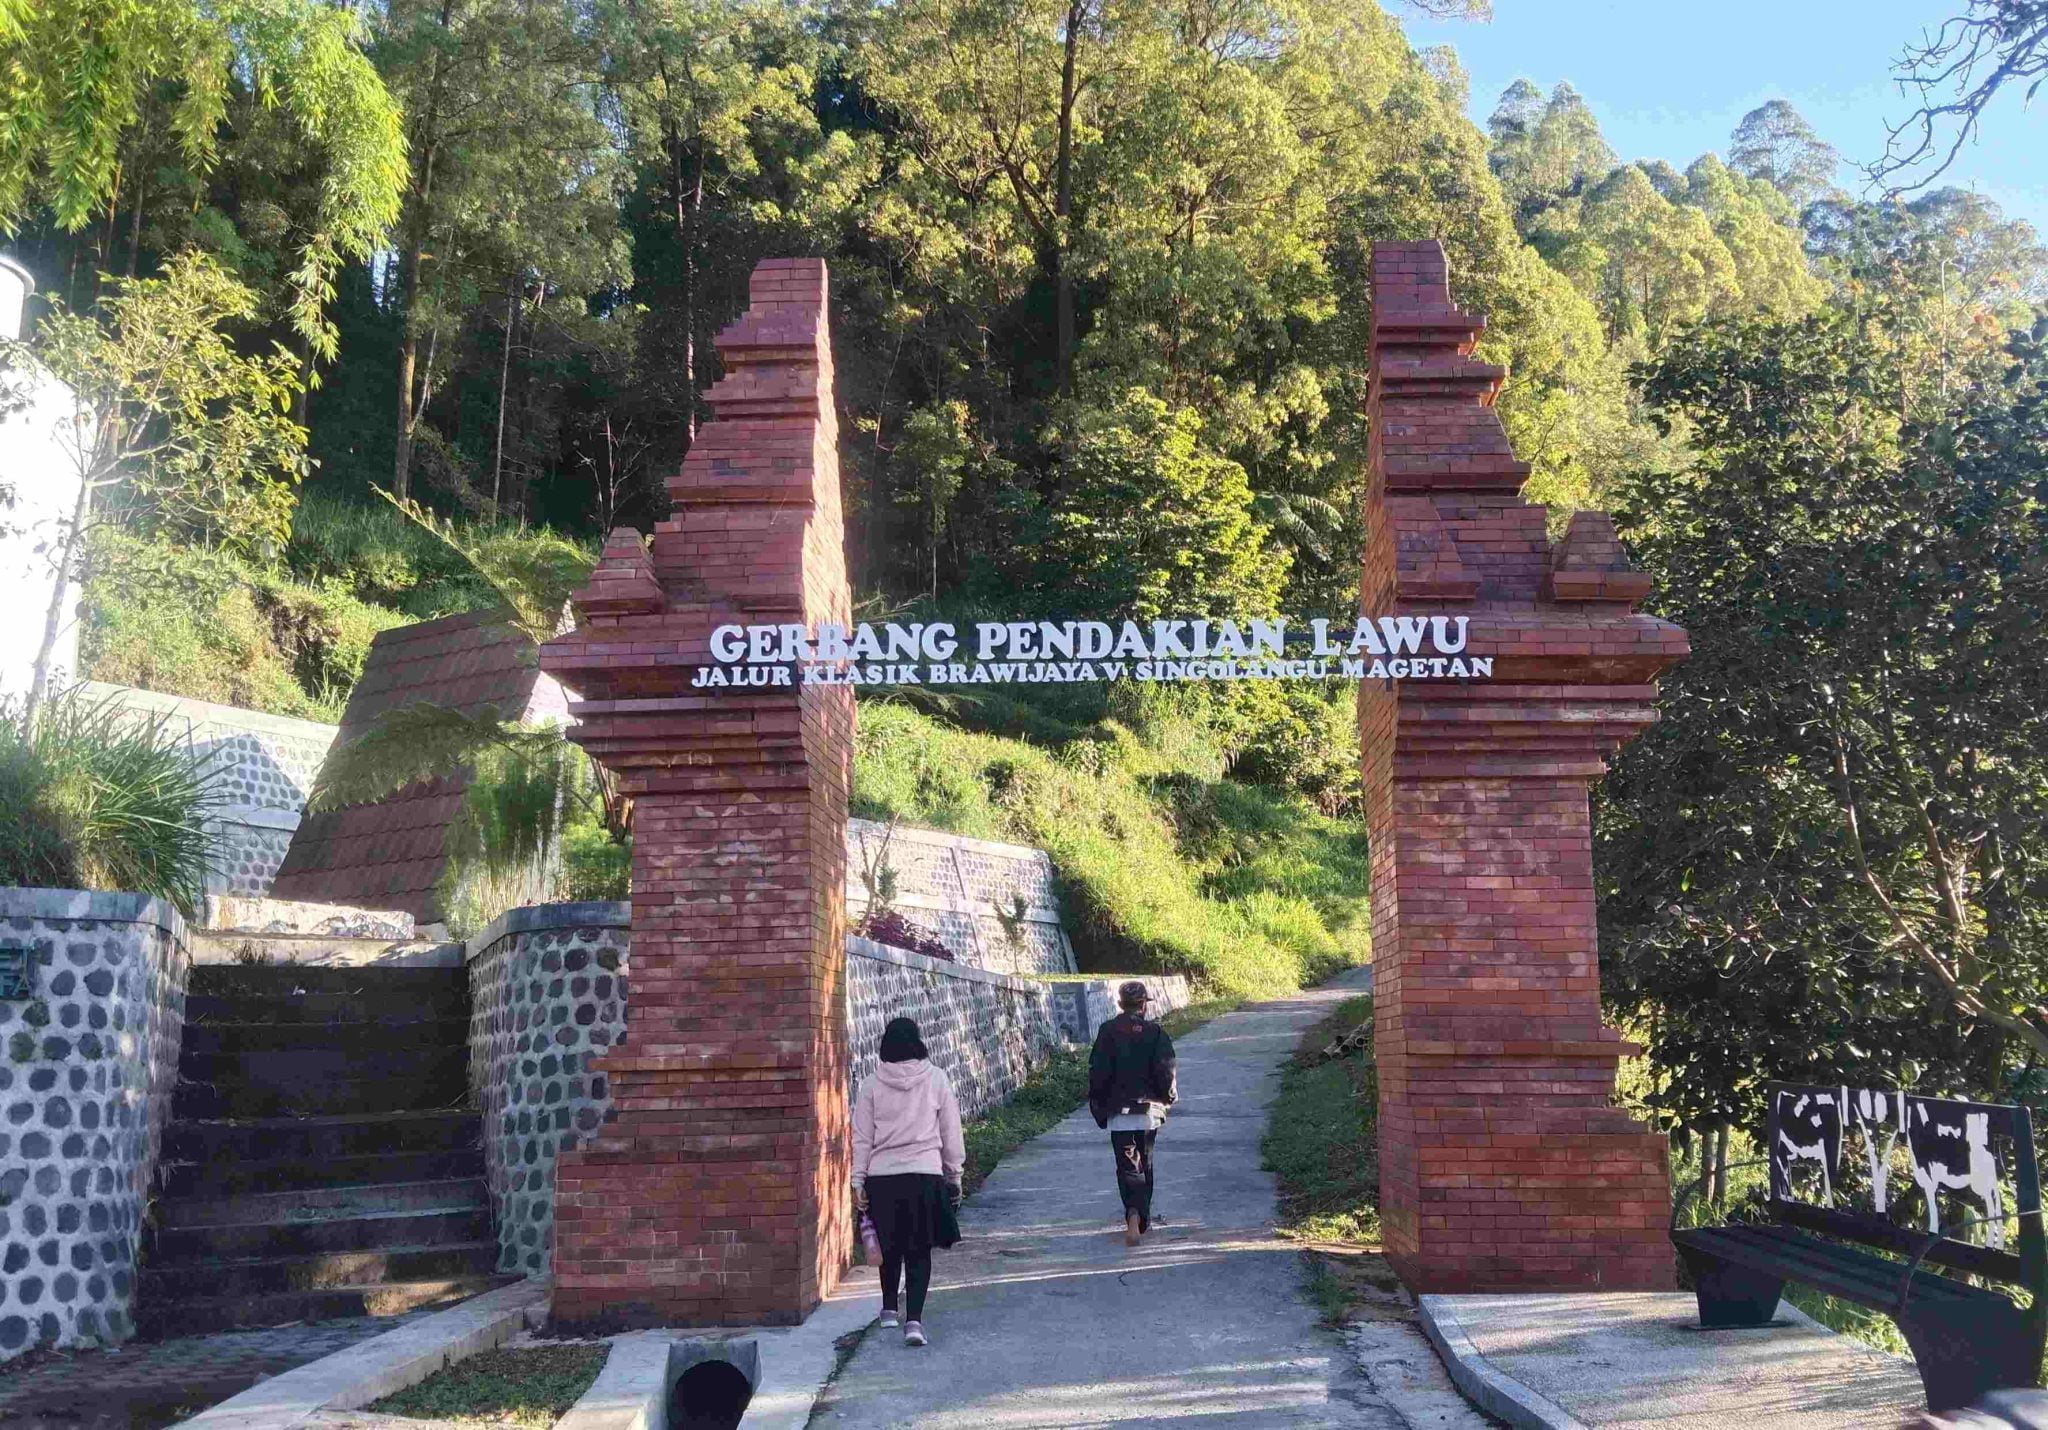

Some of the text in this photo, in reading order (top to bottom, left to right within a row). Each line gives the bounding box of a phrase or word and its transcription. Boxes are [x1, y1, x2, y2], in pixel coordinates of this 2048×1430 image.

[710, 617, 1470, 663] GERBANG PENDAKIAN LAWU
[691, 667, 793, 687] JALUR
[801, 665, 921, 684] KLASIK
[928, 663, 1100, 684] BRAWIJAYA
[1135, 660, 1328, 682] SINGOLANGU
[1340, 657, 1494, 679] MAGETAN
